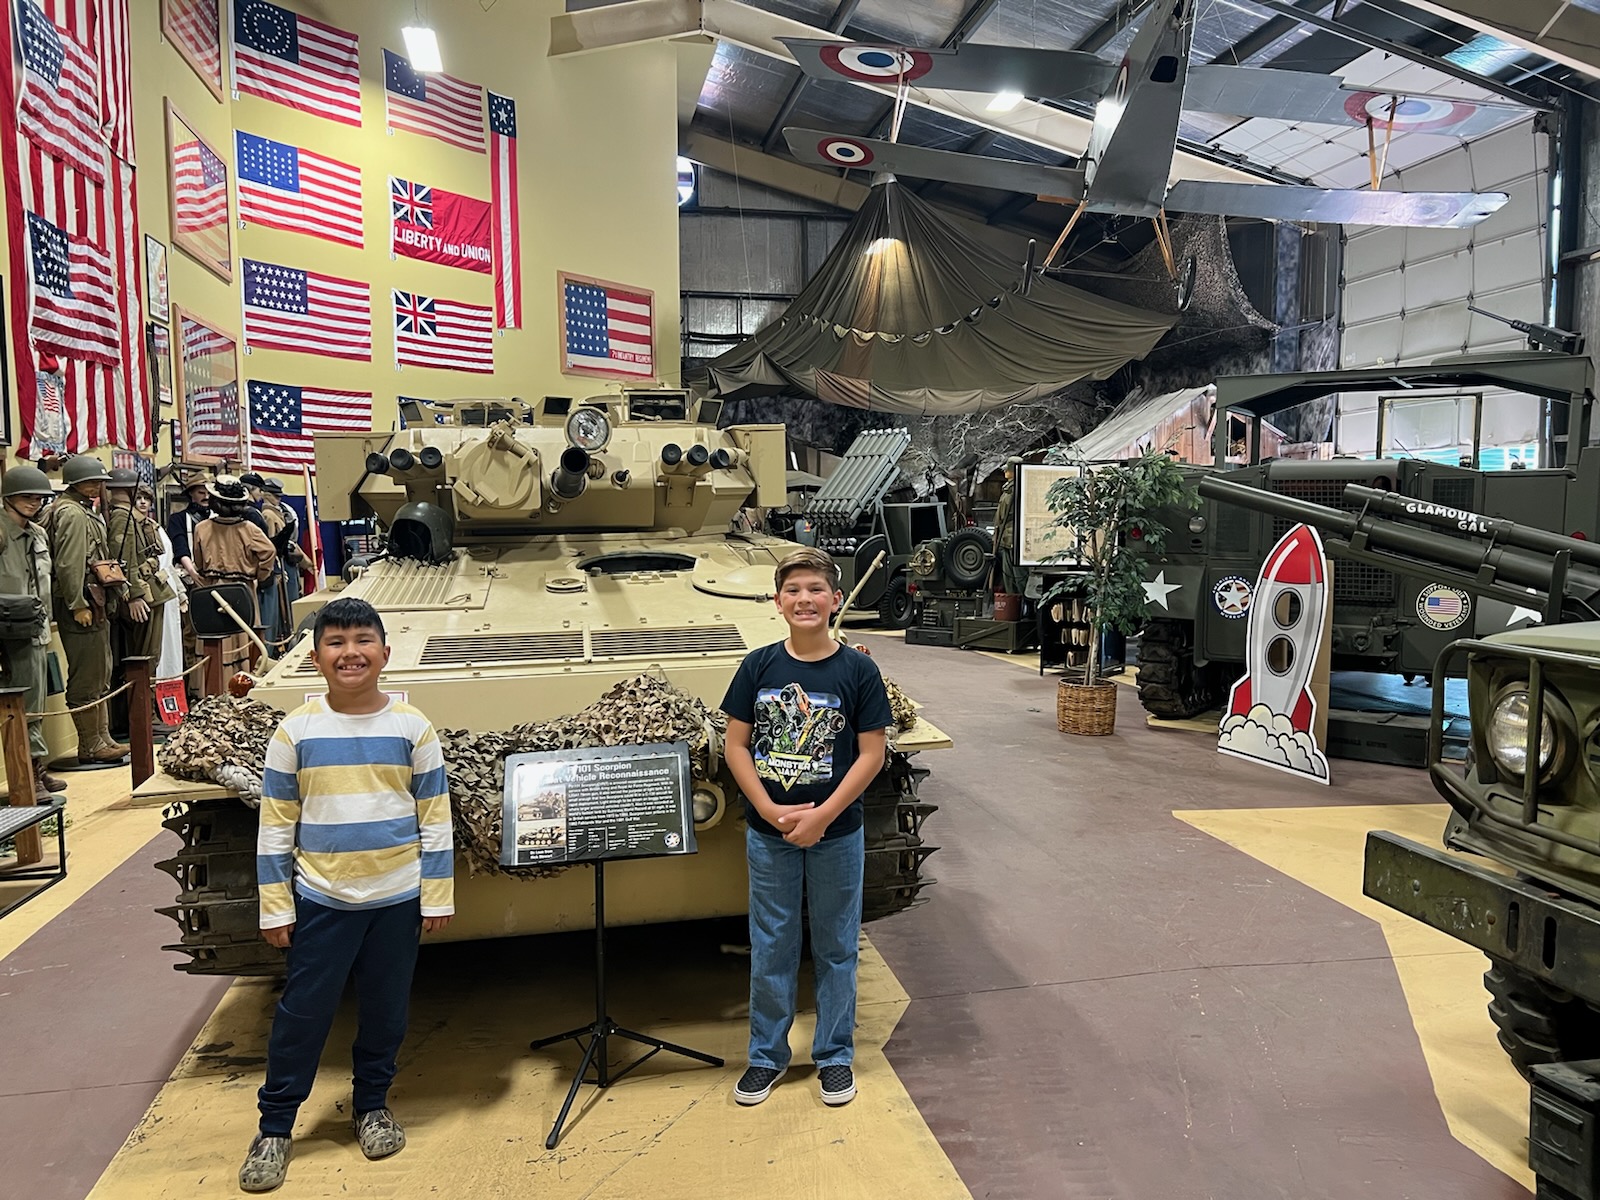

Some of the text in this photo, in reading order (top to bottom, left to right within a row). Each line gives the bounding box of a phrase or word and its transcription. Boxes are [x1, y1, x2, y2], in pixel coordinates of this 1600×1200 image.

[394, 226, 491, 263] LIBERTY AND UNION
[1418, 602, 1468, 628] WOUNDED VETERANS
[594, 762, 632, 772] Scorpion
[768, 758, 810, 770] MONSTER
[566, 772, 596, 782] Vehicle
[600, 768, 669, 780] Reconnaissance
[780, 768, 798, 776] JAM
